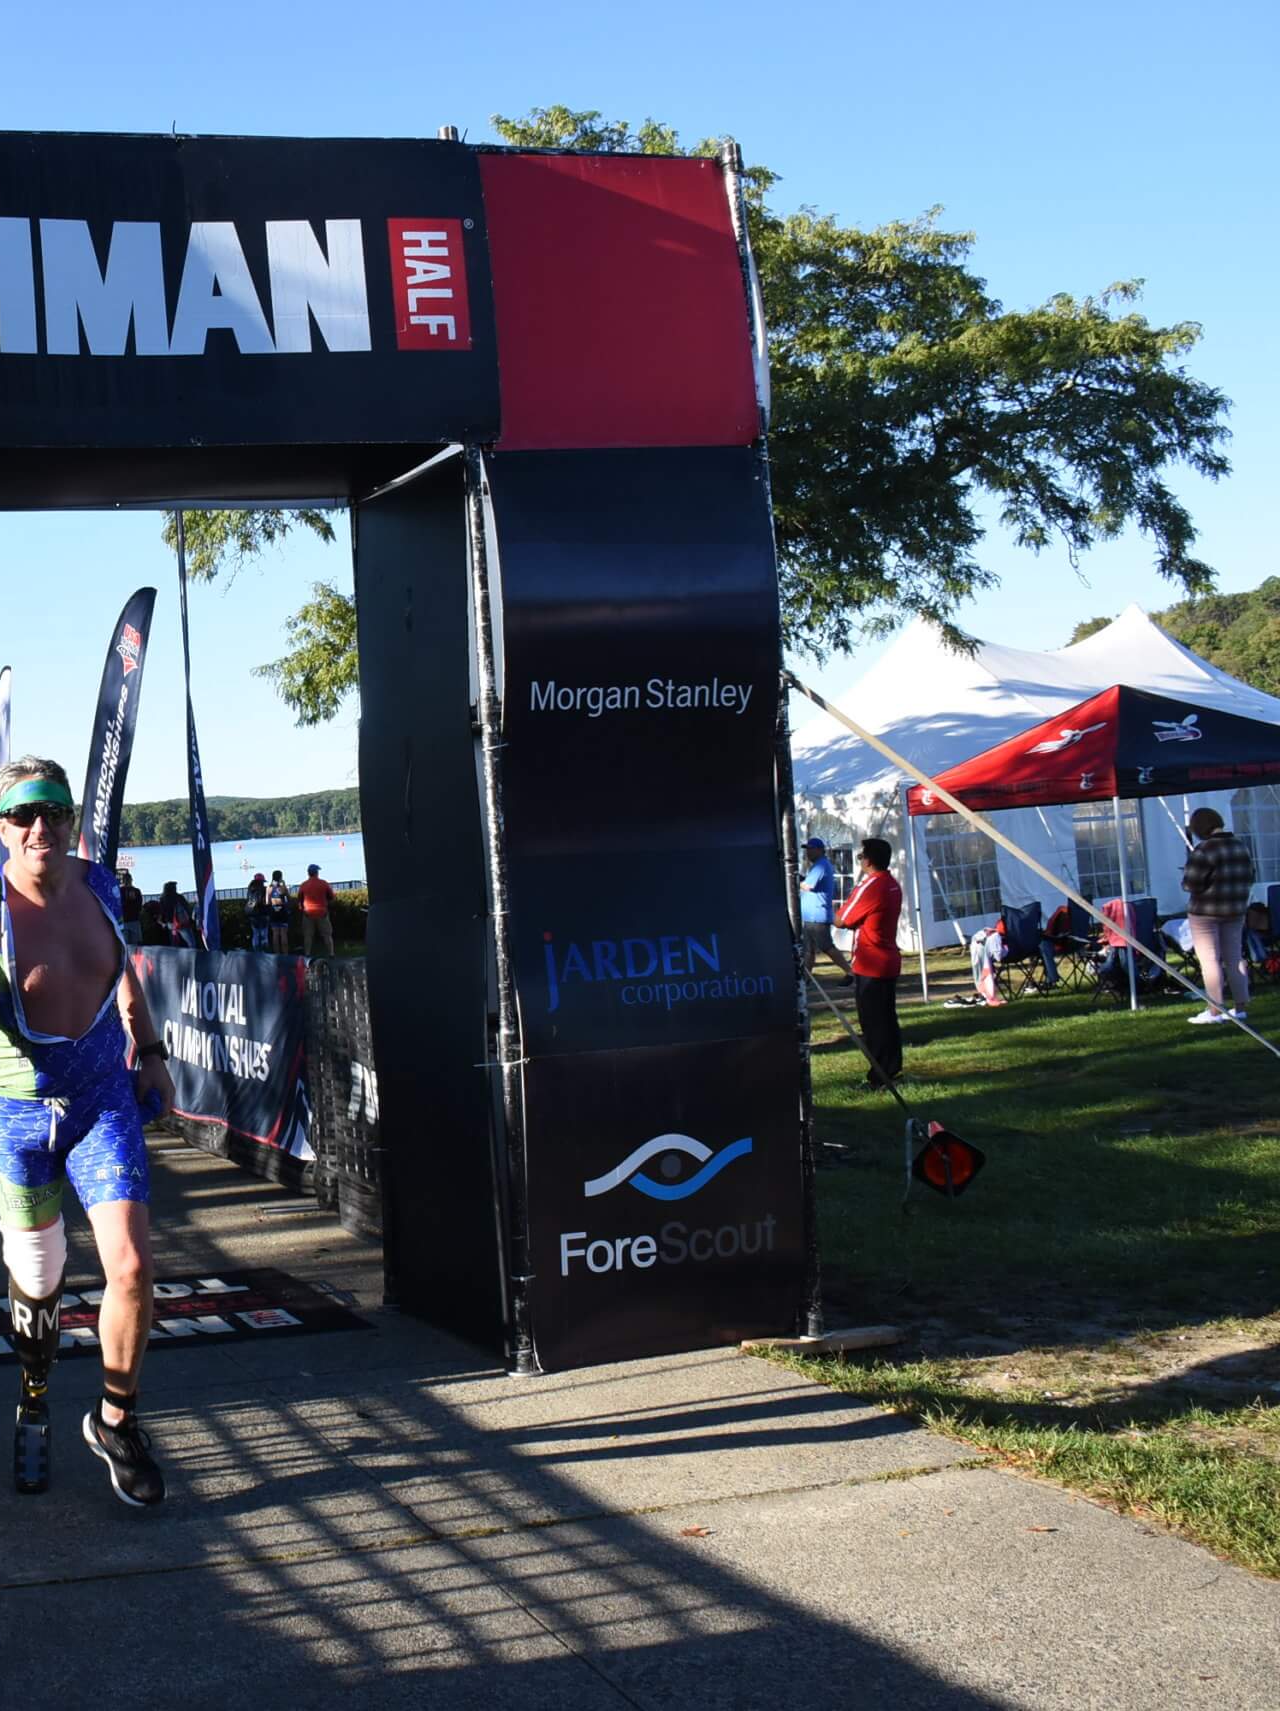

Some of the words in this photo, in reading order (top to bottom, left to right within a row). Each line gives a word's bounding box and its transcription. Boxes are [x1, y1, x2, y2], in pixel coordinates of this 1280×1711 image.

[402, 231, 456, 341] HALF
[530, 680, 640, 717] Morgan
[646, 677, 753, 714] Stanley
[93, 719, 116, 837] NATIONAL
[621, 971, 775, 1010] corporation
[560, 1214, 777, 1277] ForeScout
